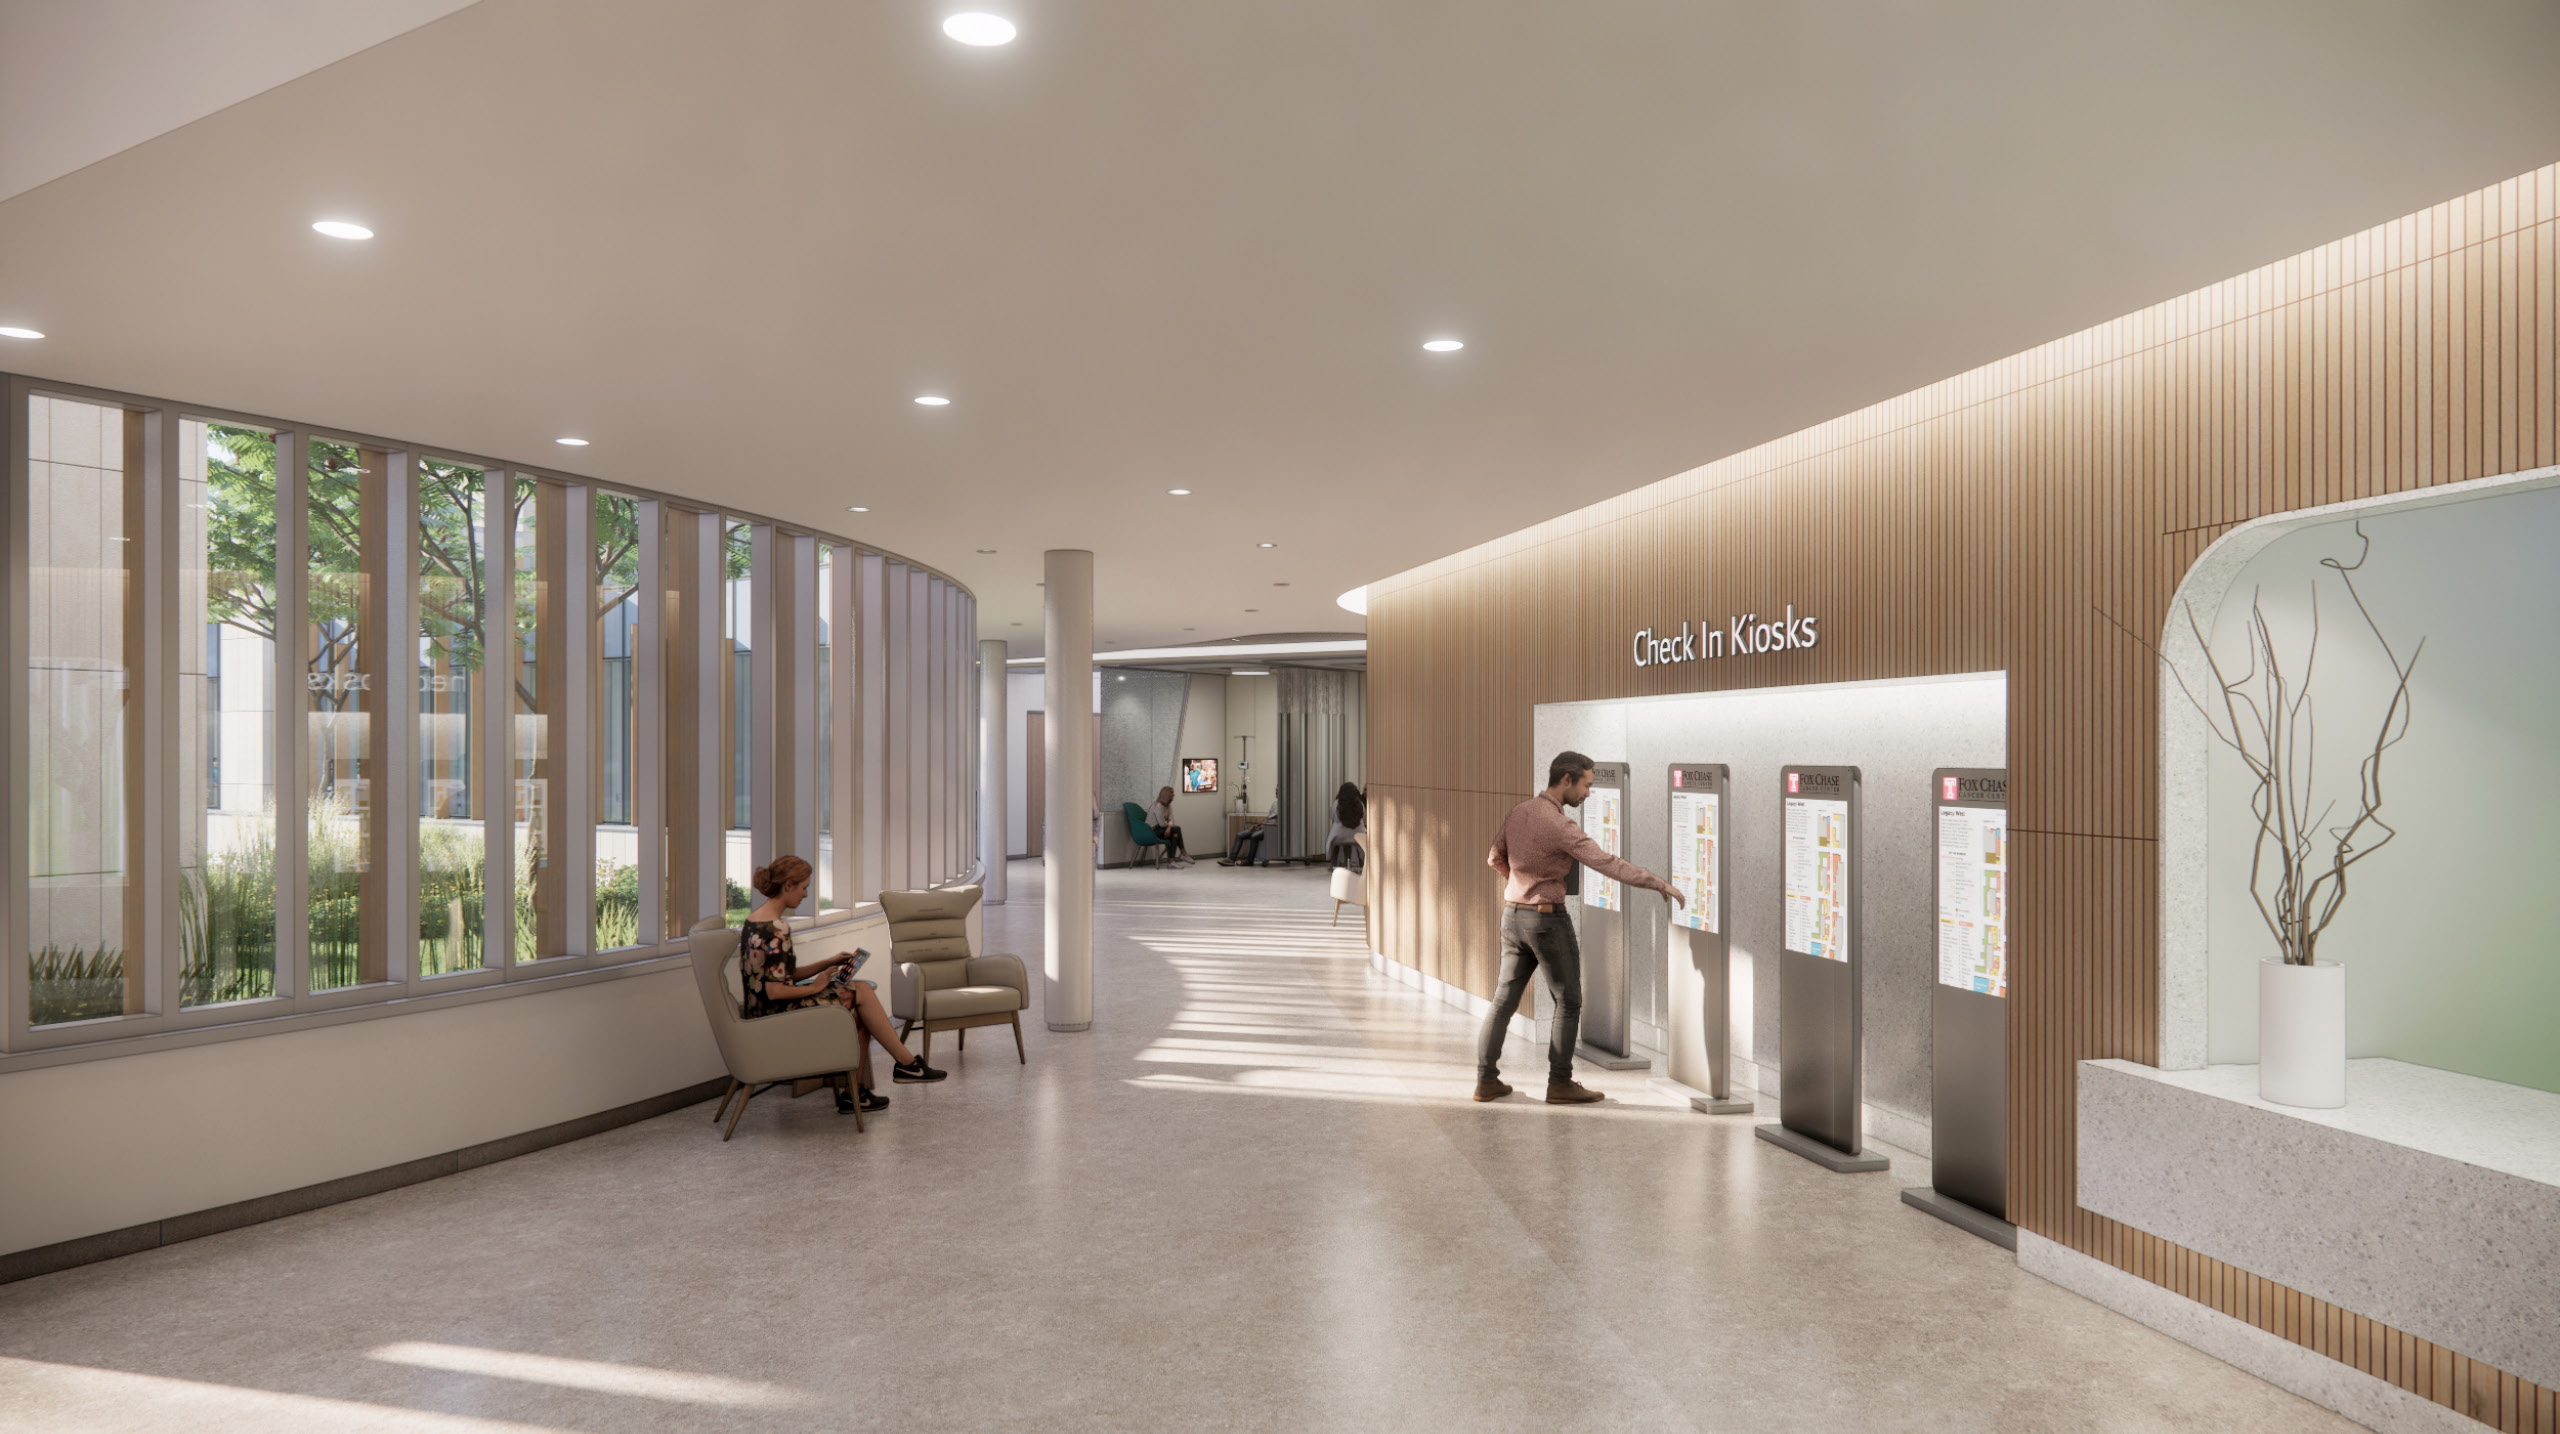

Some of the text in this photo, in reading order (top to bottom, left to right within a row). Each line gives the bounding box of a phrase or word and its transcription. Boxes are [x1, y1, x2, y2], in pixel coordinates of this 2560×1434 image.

[1633, 603, 1819, 667] Check In Kiosks
[1682, 771, 1712, 781] FOX CHASE
[1800, 773, 1840, 786] FOX CHASE
[1958, 778, 2006, 792] FOX CHAS
[1958, 791, 2006, 800] CANCER CENT
